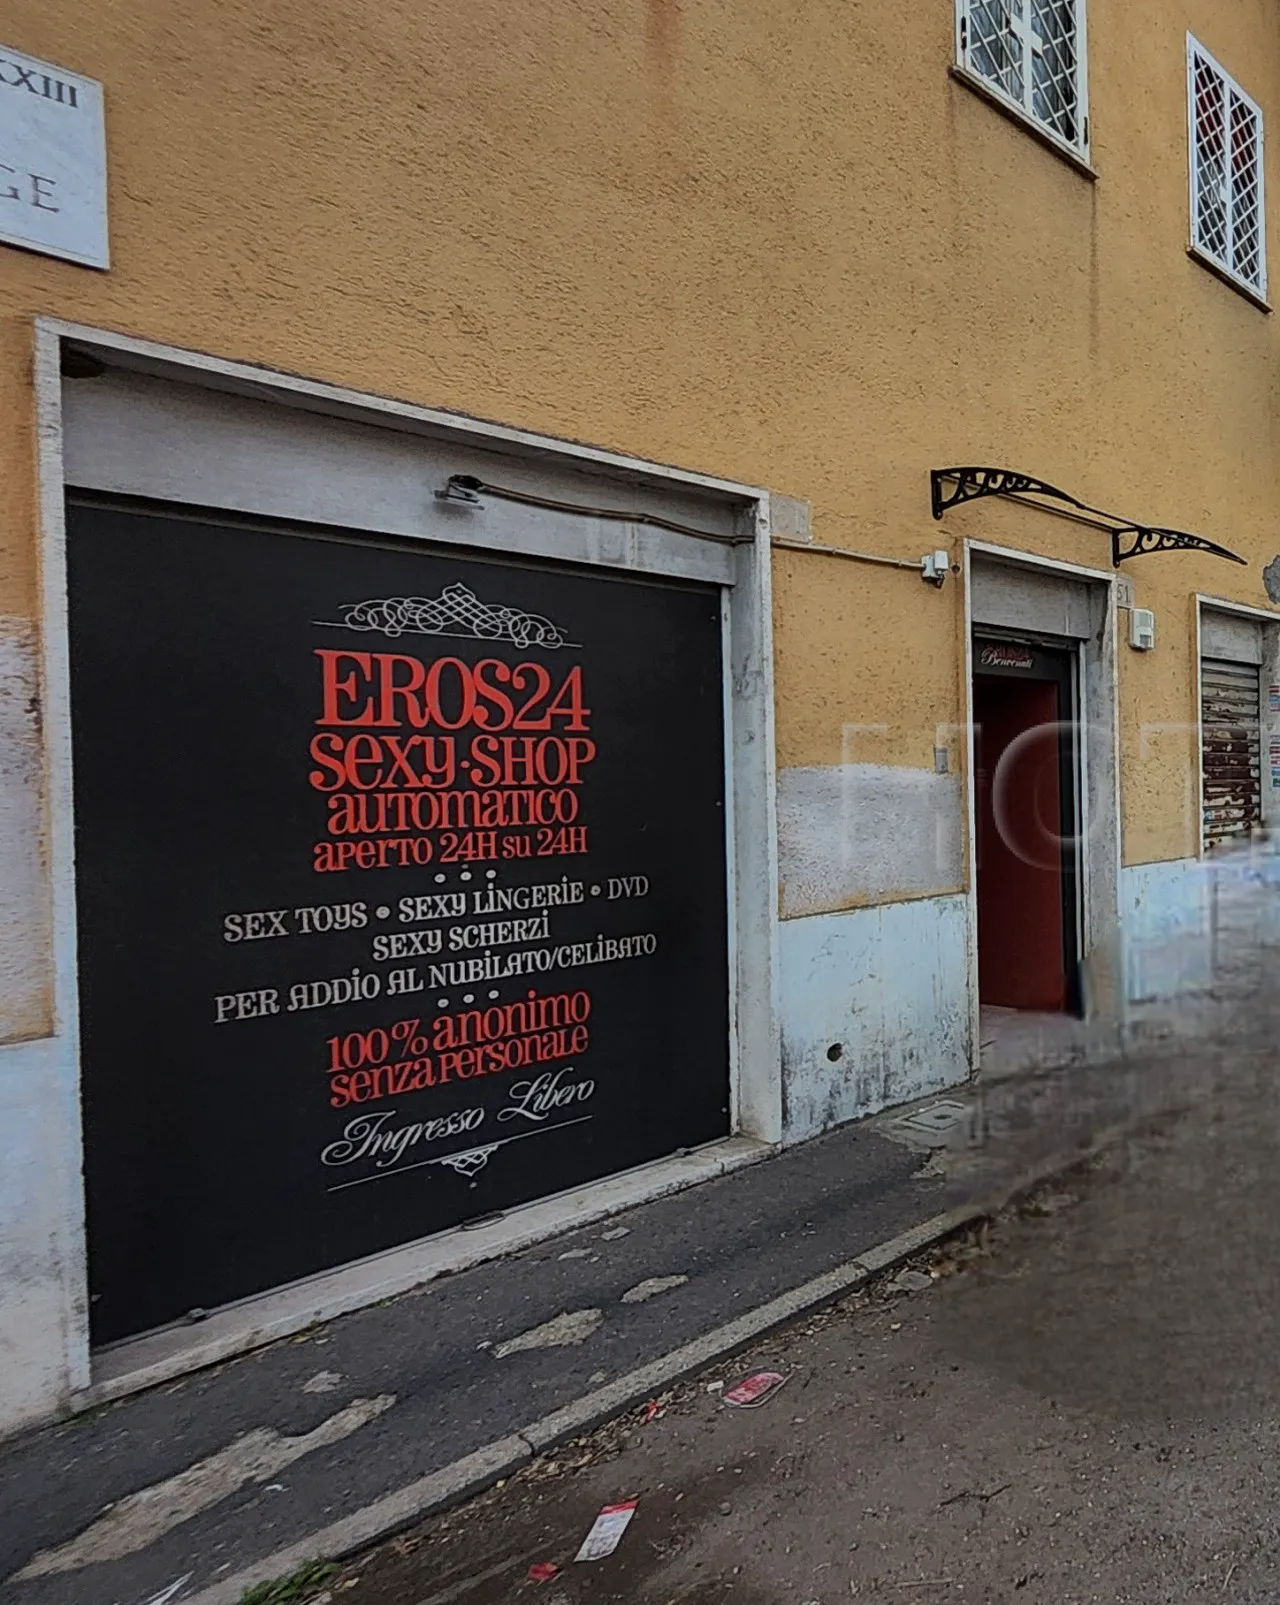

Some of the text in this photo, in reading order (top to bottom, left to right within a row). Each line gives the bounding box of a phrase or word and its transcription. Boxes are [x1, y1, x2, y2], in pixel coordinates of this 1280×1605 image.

[313, 648, 591, 732] EROS24
[439, 831, 499, 863] 24H
[502, 835, 532, 859] su
[537, 826, 588, 856] 24H
[223, 910, 290, 943] SEX
[294, 901, 368, 934] TOYS
[398, 892, 467, 923] SEXY
[607, 876, 649, 899] DVD
[372, 926, 443, 961] SEXY
[214, 988, 280, 1024] PER
[386, 967, 425, 996] AL
[326, 989, 591, 1073] 100% anonimo
[330, 1057, 437, 1108] senza
[320, 1066, 595, 1168] Ingresso Libero
